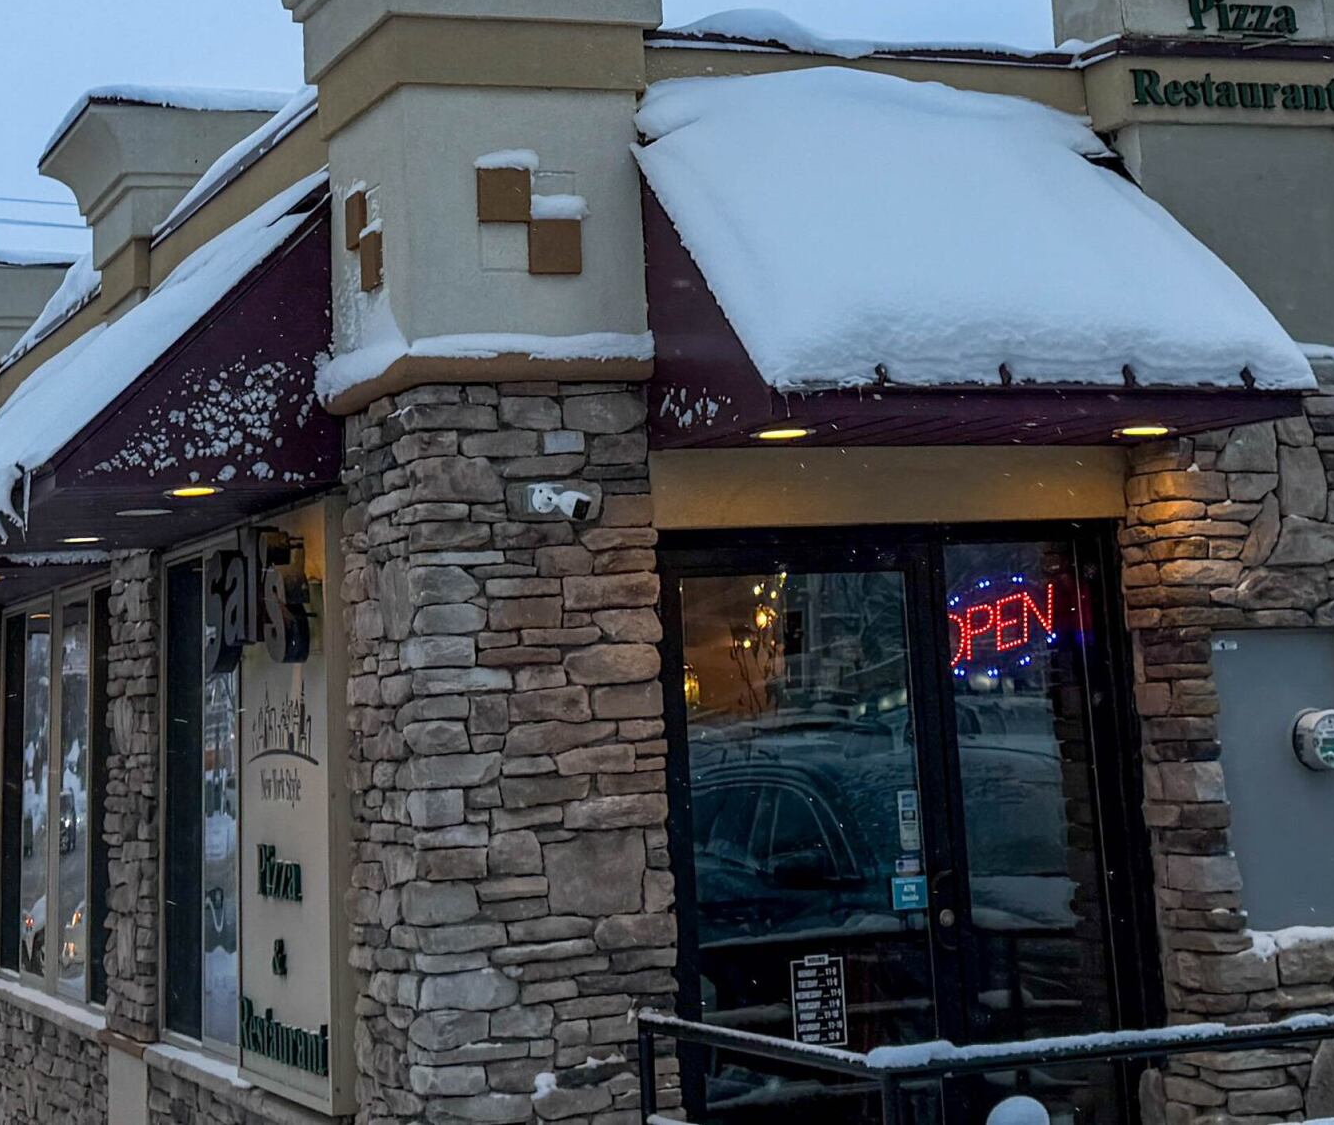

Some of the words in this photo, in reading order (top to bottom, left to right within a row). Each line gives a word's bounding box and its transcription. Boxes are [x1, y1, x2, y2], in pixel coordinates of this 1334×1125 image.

[257, 843, 302, 902] Pizza
[272, 938, 288, 977] &
[240, 995, 328, 1076] Restaurant
